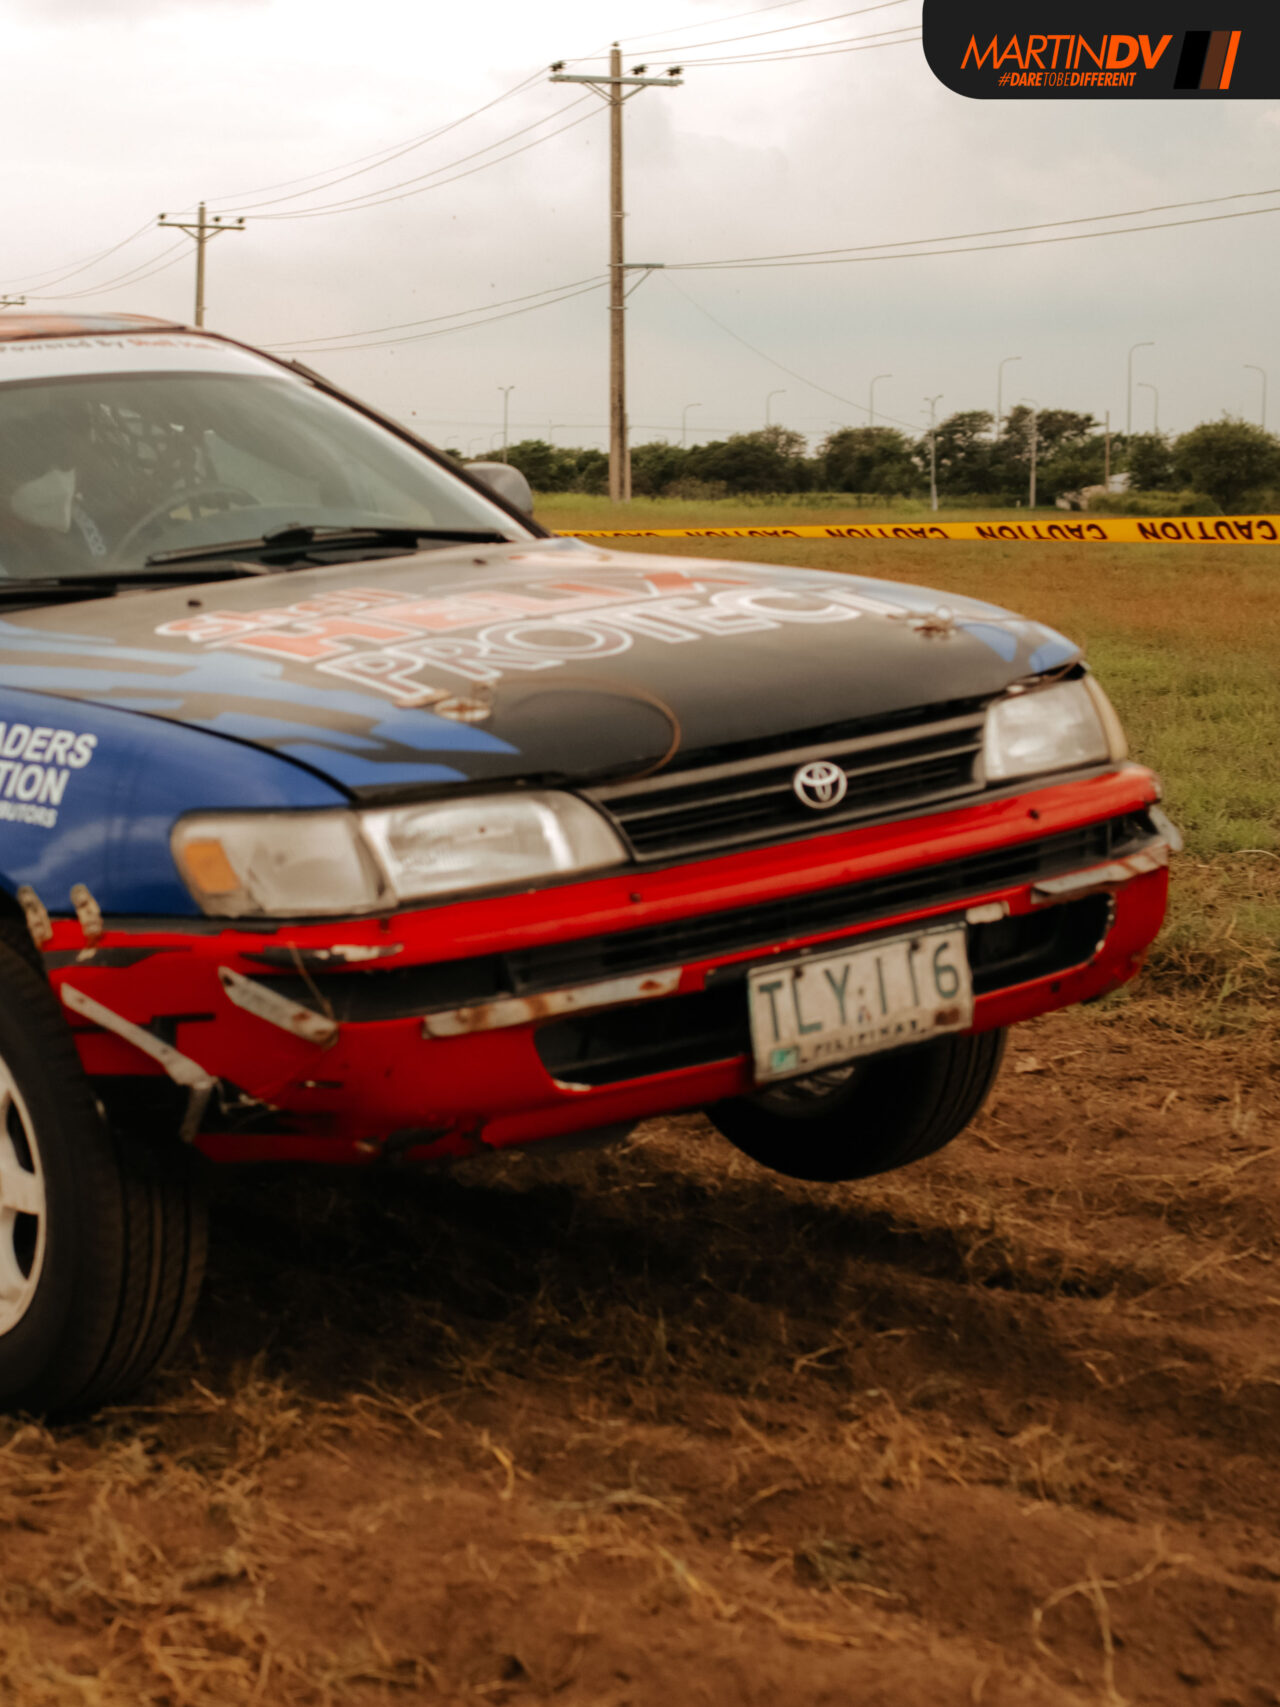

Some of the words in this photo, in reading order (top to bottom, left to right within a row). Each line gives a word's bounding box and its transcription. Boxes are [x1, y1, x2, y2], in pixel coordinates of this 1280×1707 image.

[825, 527, 950, 540] CAUTION
[975, 523, 1108, 540] CAUTION
[1137, 520, 1278, 541] CAUTION
[315, 583, 916, 699] PROTECT
[758, 964, 850, 1042] TLY
[876, 941, 960, 1015] 116
